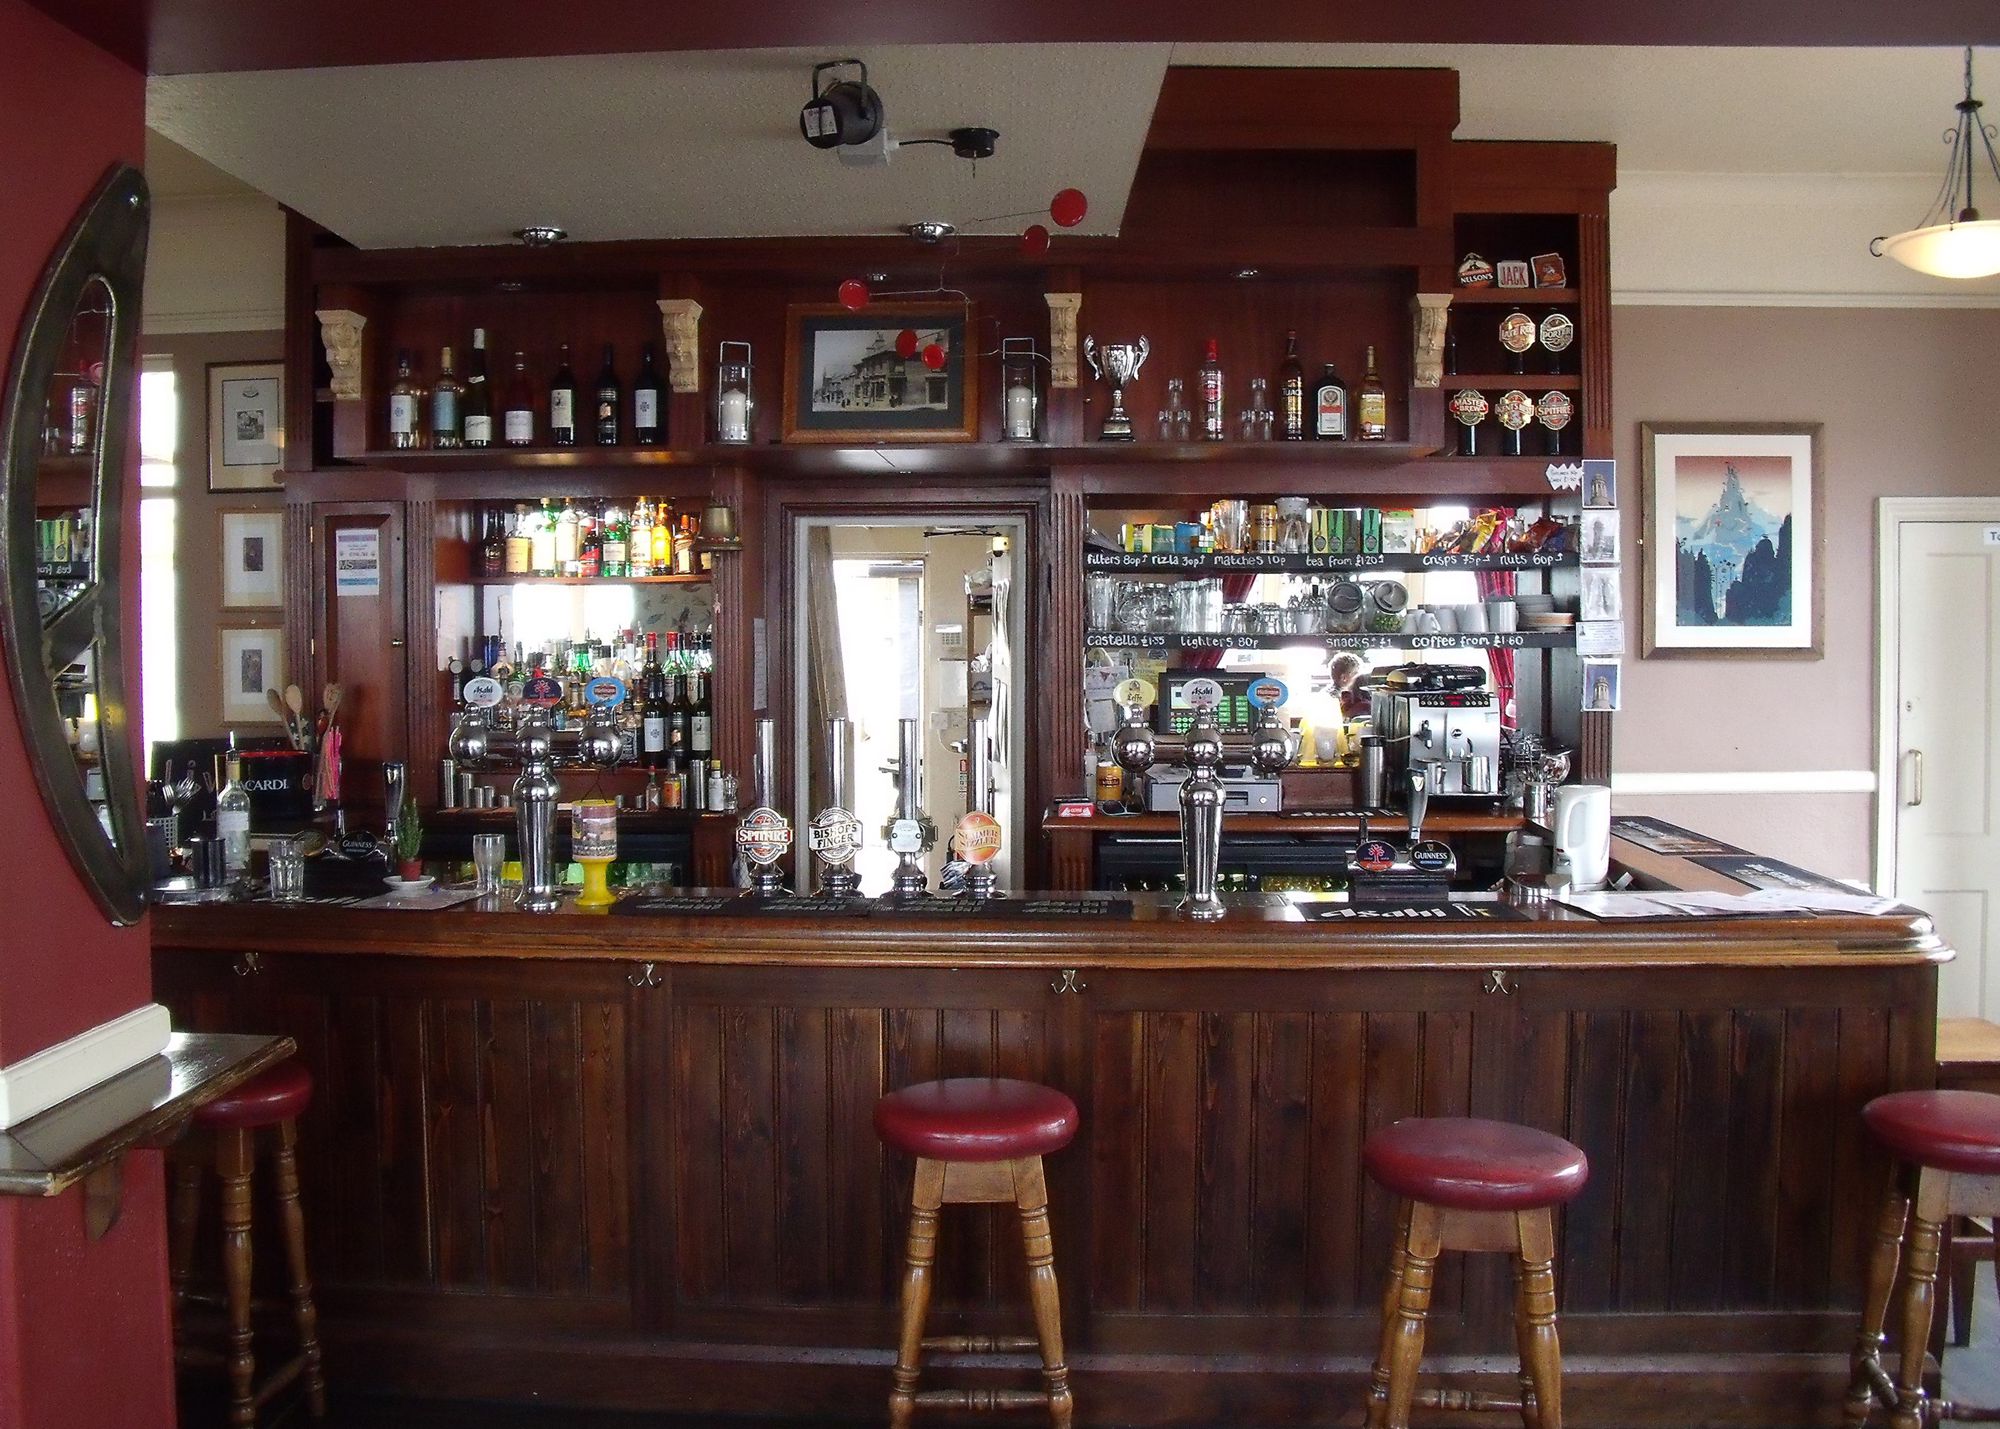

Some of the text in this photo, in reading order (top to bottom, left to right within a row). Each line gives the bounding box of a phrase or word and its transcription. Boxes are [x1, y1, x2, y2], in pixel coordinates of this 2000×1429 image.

[1460, 272, 1494, 284] NELSON'S
[1501, 265, 1527, 286] JACK
[1542, 328, 1571, 340] PORTER
[1538, 405, 1571, 416] SPITFIRE
[1087, 553, 1141, 567] filters 80p
[1151, 554, 1199, 567] rizla 30p
[1214, 555, 1264, 566] matches
[1306, 555, 1324, 566] tea
[1328, 555, 1353, 567] from
[1461, 554, 1480, 566] 75p
[1500, 554, 1553, 567] nuts 60p
[1181, 636, 1259, 649] lighters 80p
[1326, 637, 1370, 647] snacks
[1460, 636, 1490, 647] from
[473, 685, 493, 694] Asahi
[1191, 687, 1213, 696] Asahi
[1127, 693, 1143, 703] Leffe
[739, 829, 788, 843] SPITFIRE
[958, 828, 998, 840] SUMMER
[342, 840, 373, 849] GUINNESS
[817, 834, 855, 848] FINGER
[1413, 850, 1449, 861] GUINNESS
